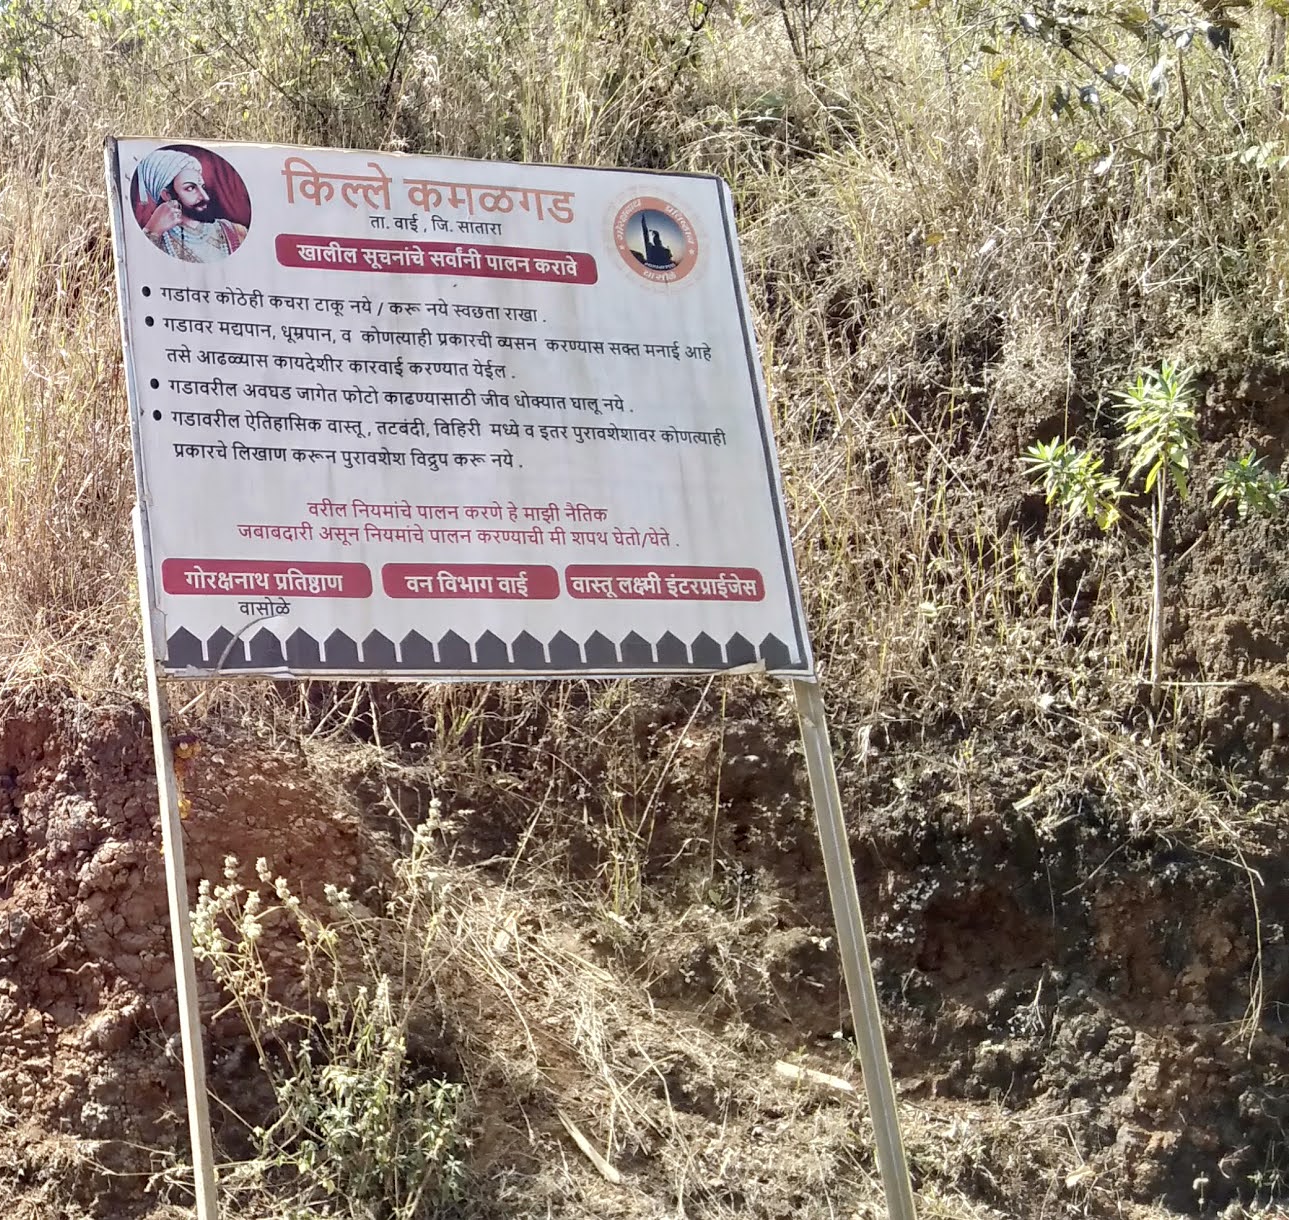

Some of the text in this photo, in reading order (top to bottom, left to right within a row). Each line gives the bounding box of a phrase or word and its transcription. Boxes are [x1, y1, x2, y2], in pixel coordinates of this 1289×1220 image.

[281, 157, 575, 224] किल्ले कमळगड
[369, 216, 390, 230] ता.
[393, 213, 418, 233] वाई
[431, 215, 454, 233] जि.
[456, 221, 502, 236] सातारा
[296, 241, 578, 277] खालील सूचनांचे सर्वांनी पालन करावे
[214, 287, 264, 309] कोठेही
[268, 295, 309, 310] कचरा
[313, 298, 345, 316] टाकू
[348, 296, 372, 314] नये
[377, 302, 383, 317] /
[388, 302, 421, 316] करू
[425, 298, 448, 316] नये
[452, 304, 500, 320] स्वछता
[503, 308, 538, 323] राखा
[163, 318, 711, 361] गडावर मद्यपान, धूम्रपान, व कोणत्याही प्रकारची व्यसन करण्यास सक्त मनाई आहे
[165, 344, 191, 363] तसे
[272, 352, 344, 372] कायदेशीर
[347, 356, 403, 378] कारवाई
[407, 362, 468, 377] करण्यात
[472, 359, 506, 380] येईल
[168, 377, 238, 397] गडावरील
[243, 384, 292, 400] अवघड
[295, 383, 337, 402] जागेत
[341, 385, 379, 404] फोटो
[382, 388, 476, 406] काढण्यासाठी
[480, 390, 509, 407] जीव
[514, 390, 566, 409] धोक्यात
[569, 397, 603, 415] घालू
[602, 394, 624, 412] नये
[171, 409, 240, 428] गडावरील
[244, 410, 322, 432] ऐतिहासिक
[375, 418, 429, 437] तटबंदी,
[433, 418, 481, 438] विहिरी
[489, 419, 519, 437] मध्ये
[523, 425, 534, 438] व
[538, 425, 568, 441] इतर
[659, 426, 726, 446] कोणत्याही
[173, 440, 228, 459] प्रकारचे
[231, 441, 287, 462] लिखाण
[291, 449, 336, 463] करून
[340, 447, 406, 468] पुरावशेश
[410, 448, 448, 471] विद्रुप
[452, 453, 486, 467] करू
[490, 449, 513, 467] नये
[307, 498, 608, 524] वरील नियमांचे पालन करणे हे माझी नैतिक
[237, 521, 313, 542] जबाबदारी
[319, 527, 359, 546] असून
[363, 523, 424, 543] नियमांचे
[428, 530, 471, 544] पालन
[476, 526, 544, 545] करण्याची
[548, 527, 566, 545] मी
[570, 531, 608, 546] शपथ
[612, 527, 670, 548] घेतो/घेते
[184, 566, 343, 593] गोरक्षनाथ प्रतिष्ठाण
[404, 570, 528, 597] वन विभाग वाई
[571, 572, 757, 598] वास्तू लक्ष्मी इंटरप्राईजेस
[238, 597, 291, 616] वासोळे
